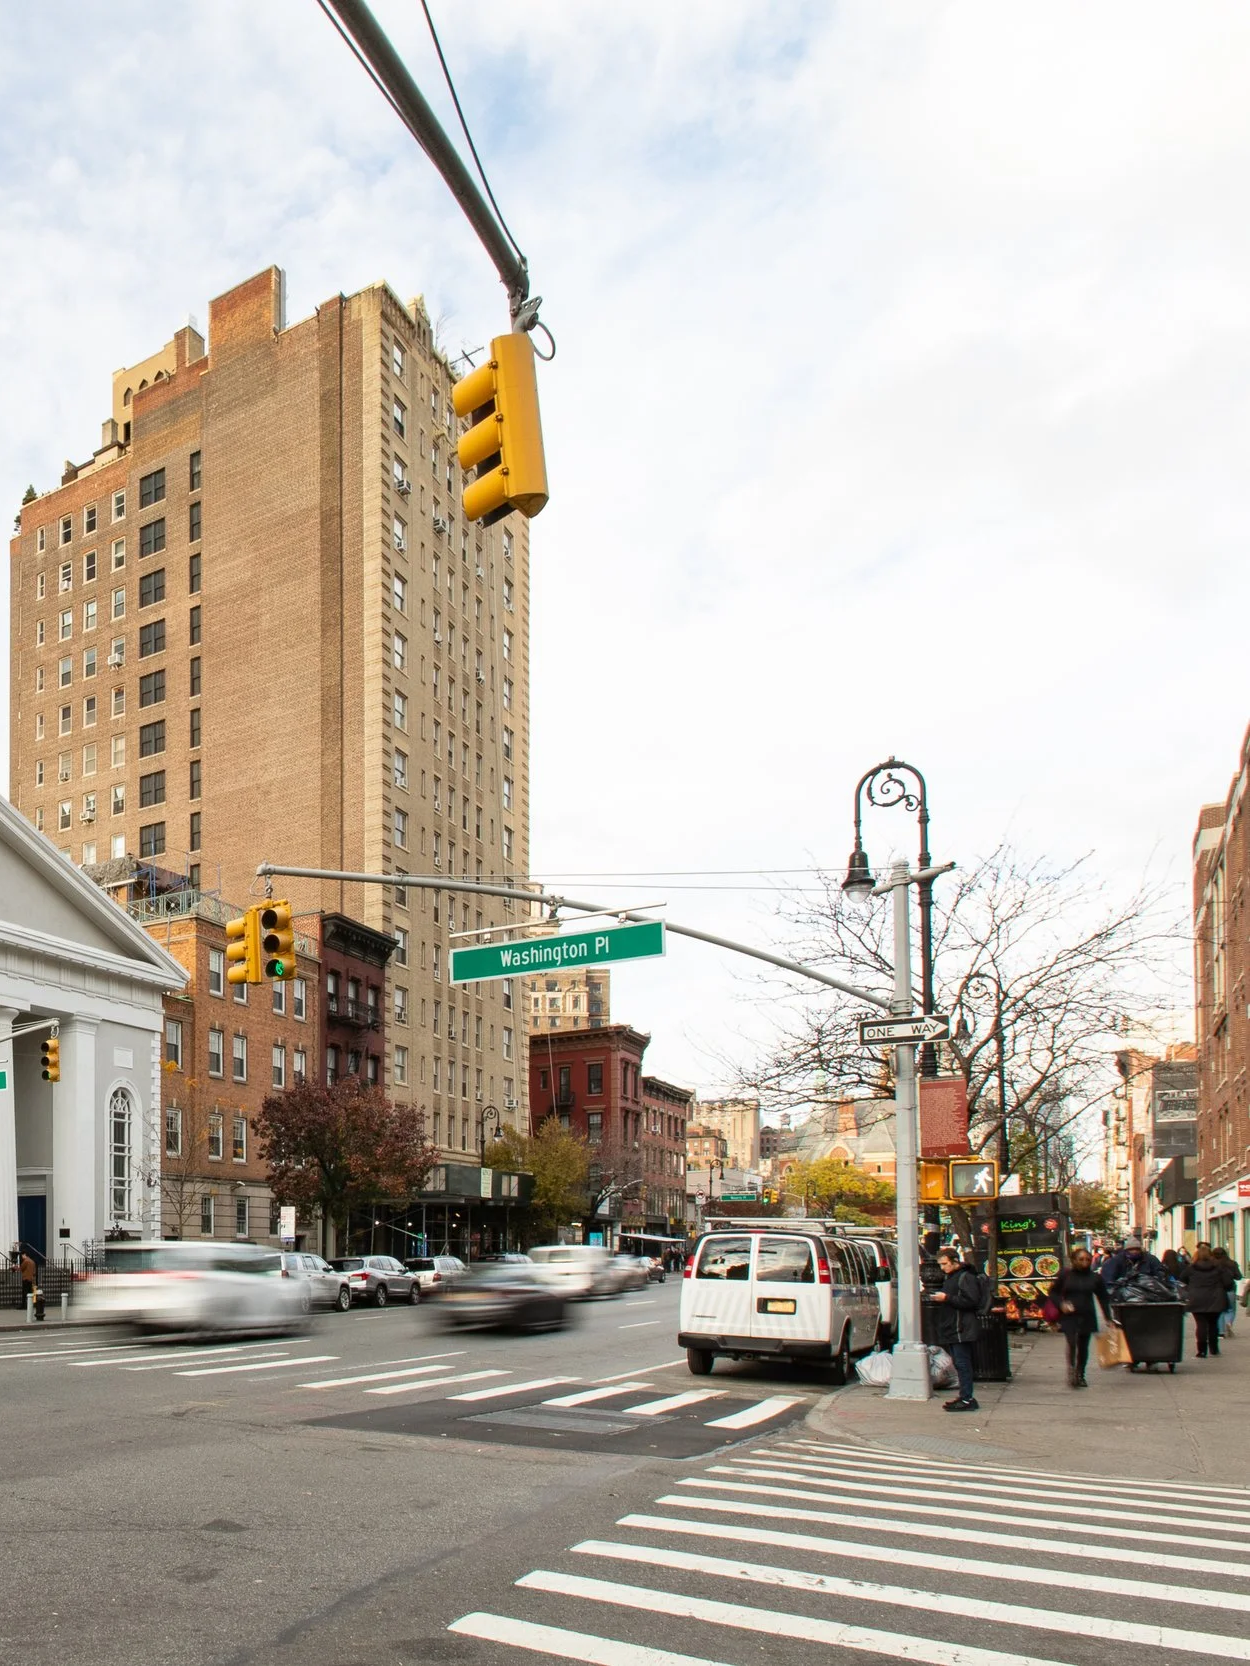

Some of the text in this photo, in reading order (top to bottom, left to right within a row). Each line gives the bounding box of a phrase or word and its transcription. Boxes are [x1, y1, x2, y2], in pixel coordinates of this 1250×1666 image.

[500, 936, 610, 967] Washington Pl
[866, 1023, 939, 1038] ONE WAY
[1001, 1219, 1036, 1230] King's
